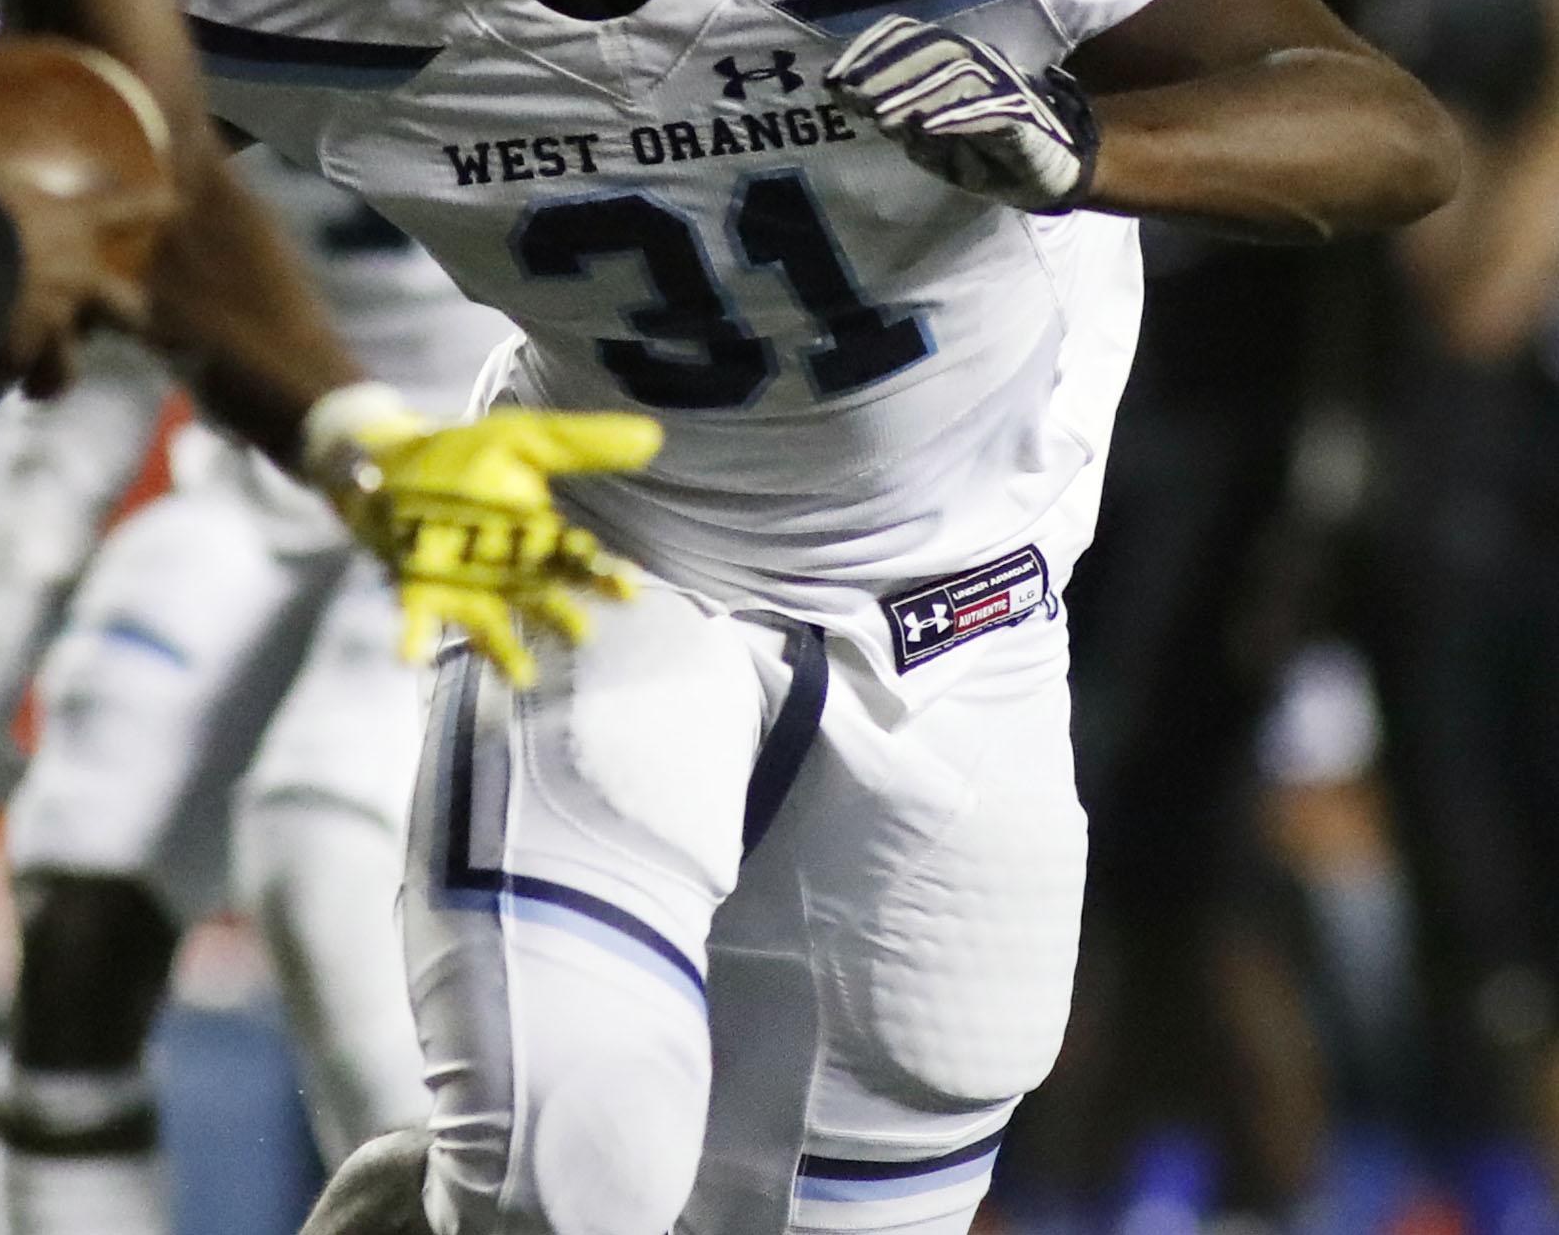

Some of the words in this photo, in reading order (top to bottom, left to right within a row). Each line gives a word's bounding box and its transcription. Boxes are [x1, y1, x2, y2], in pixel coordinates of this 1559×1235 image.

[443, 132, 600, 186] WEST
[631, 103, 857, 167] ORANGE
[505, 166, 939, 410] 31
[953, 582, 989, 600] UNDER
[990, 561, 1034, 585] ARMOUR
[958, 599, 1008, 628] AUTHENTIC
